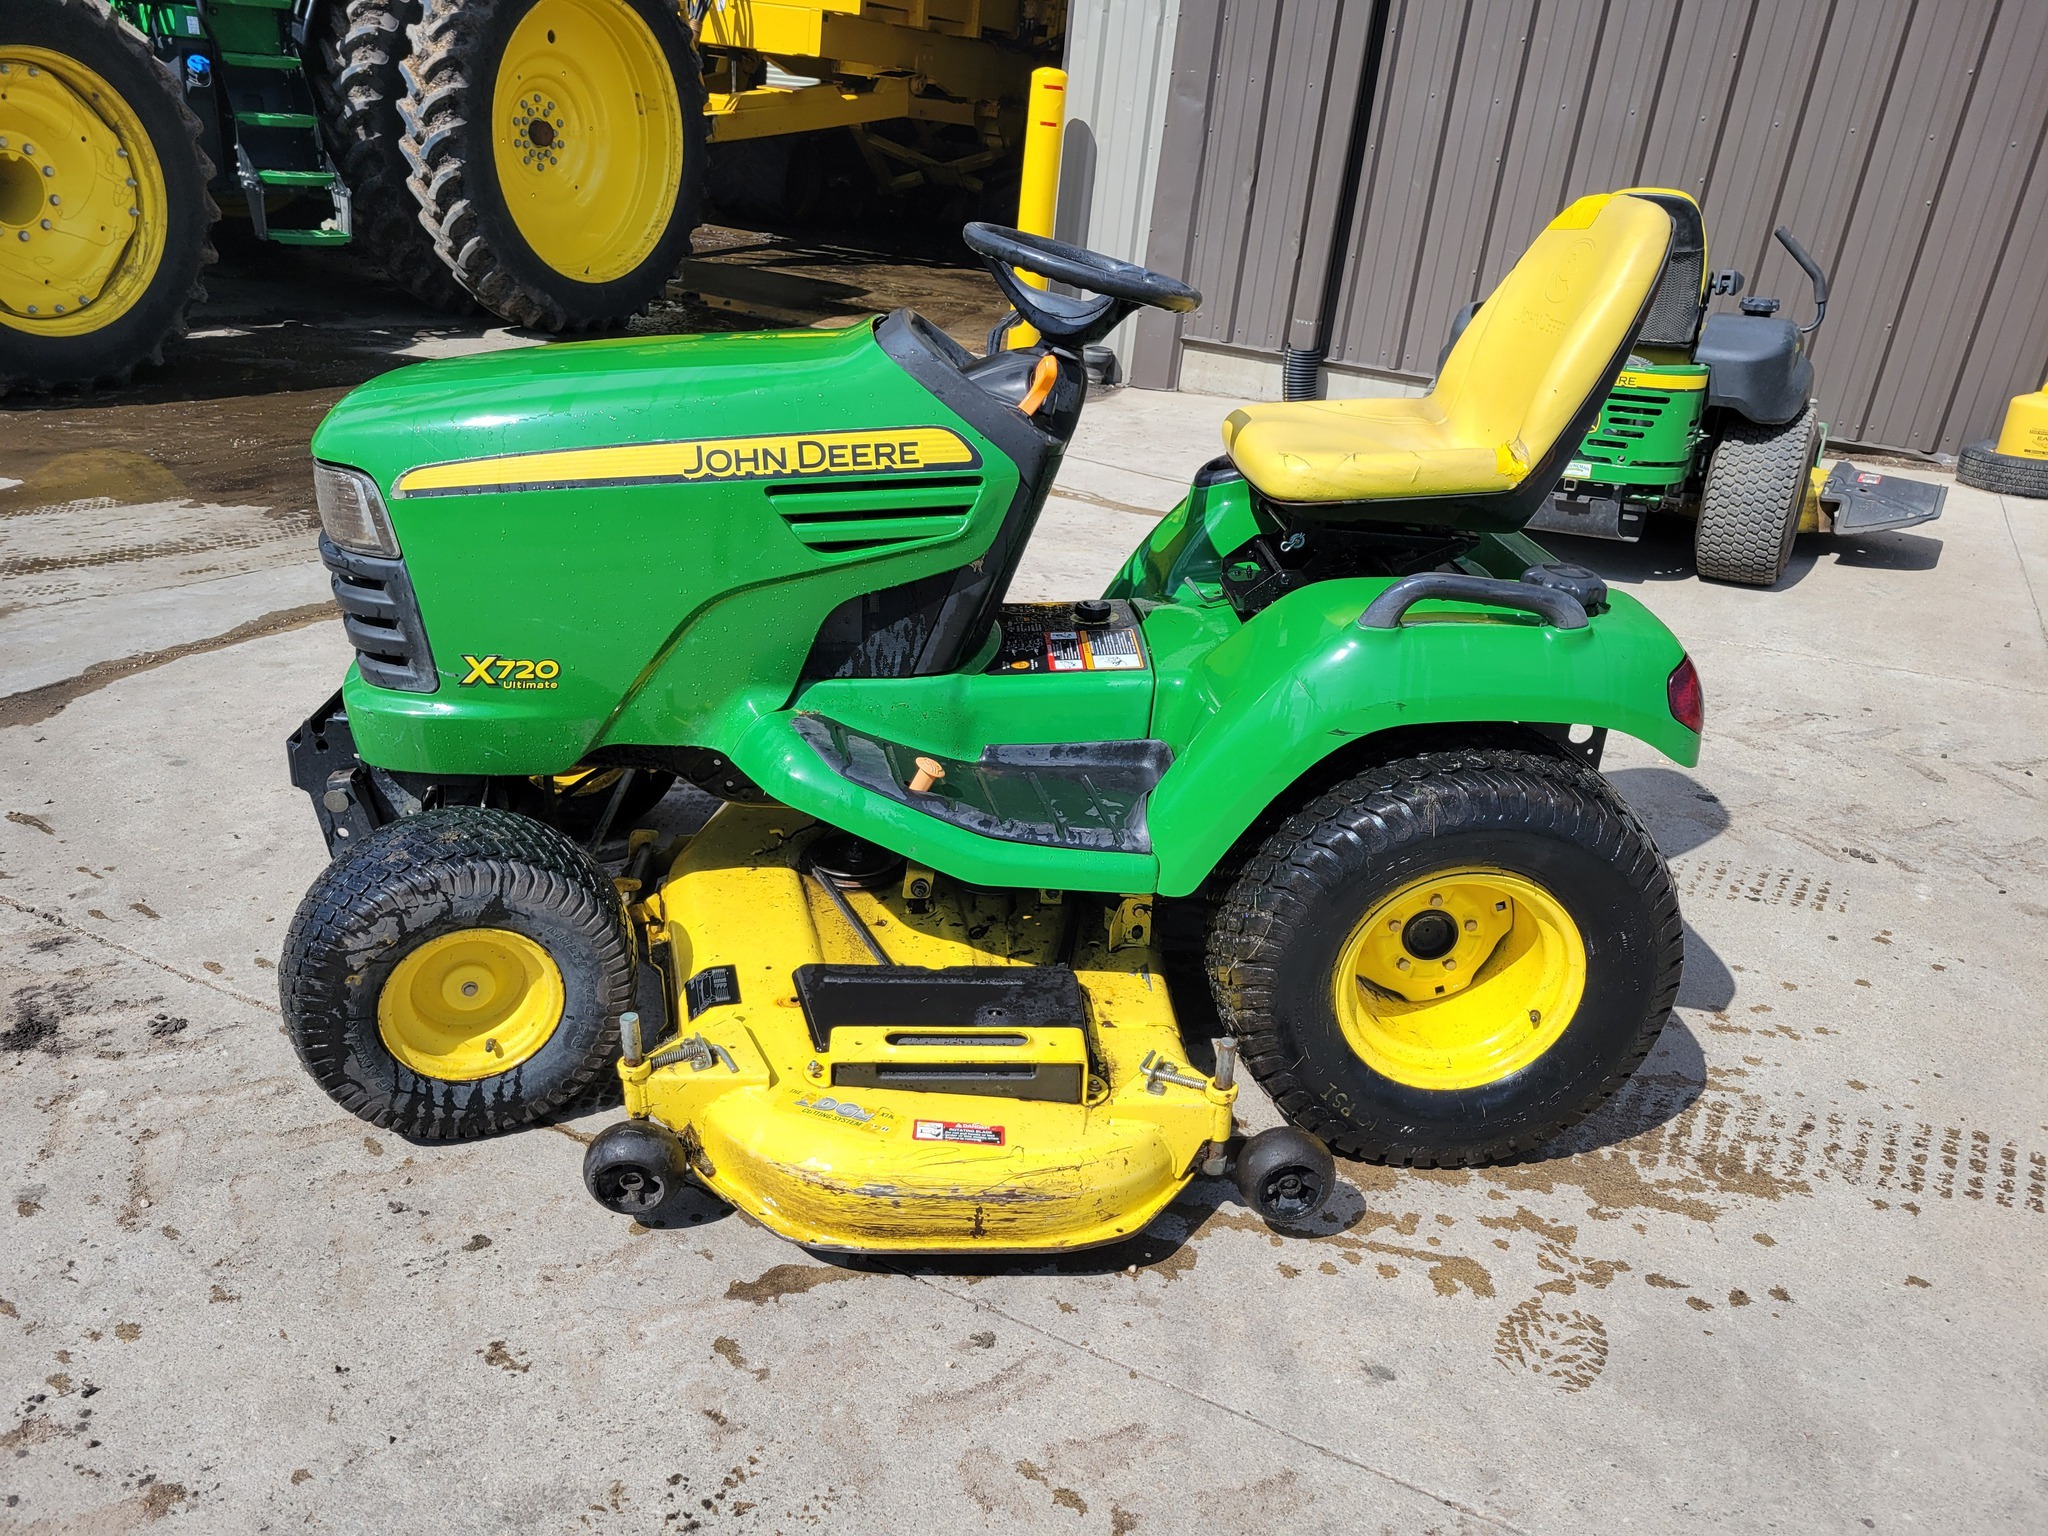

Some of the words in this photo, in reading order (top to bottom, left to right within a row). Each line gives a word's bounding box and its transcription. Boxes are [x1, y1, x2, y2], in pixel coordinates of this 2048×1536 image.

[683, 444, 788, 476] JOHN
[797, 439, 921, 470] DEERE
[458, 653, 561, 687] X720
[503, 680, 558, 689] Ultimate
[832, 1115, 863, 1127] SYSTEM
